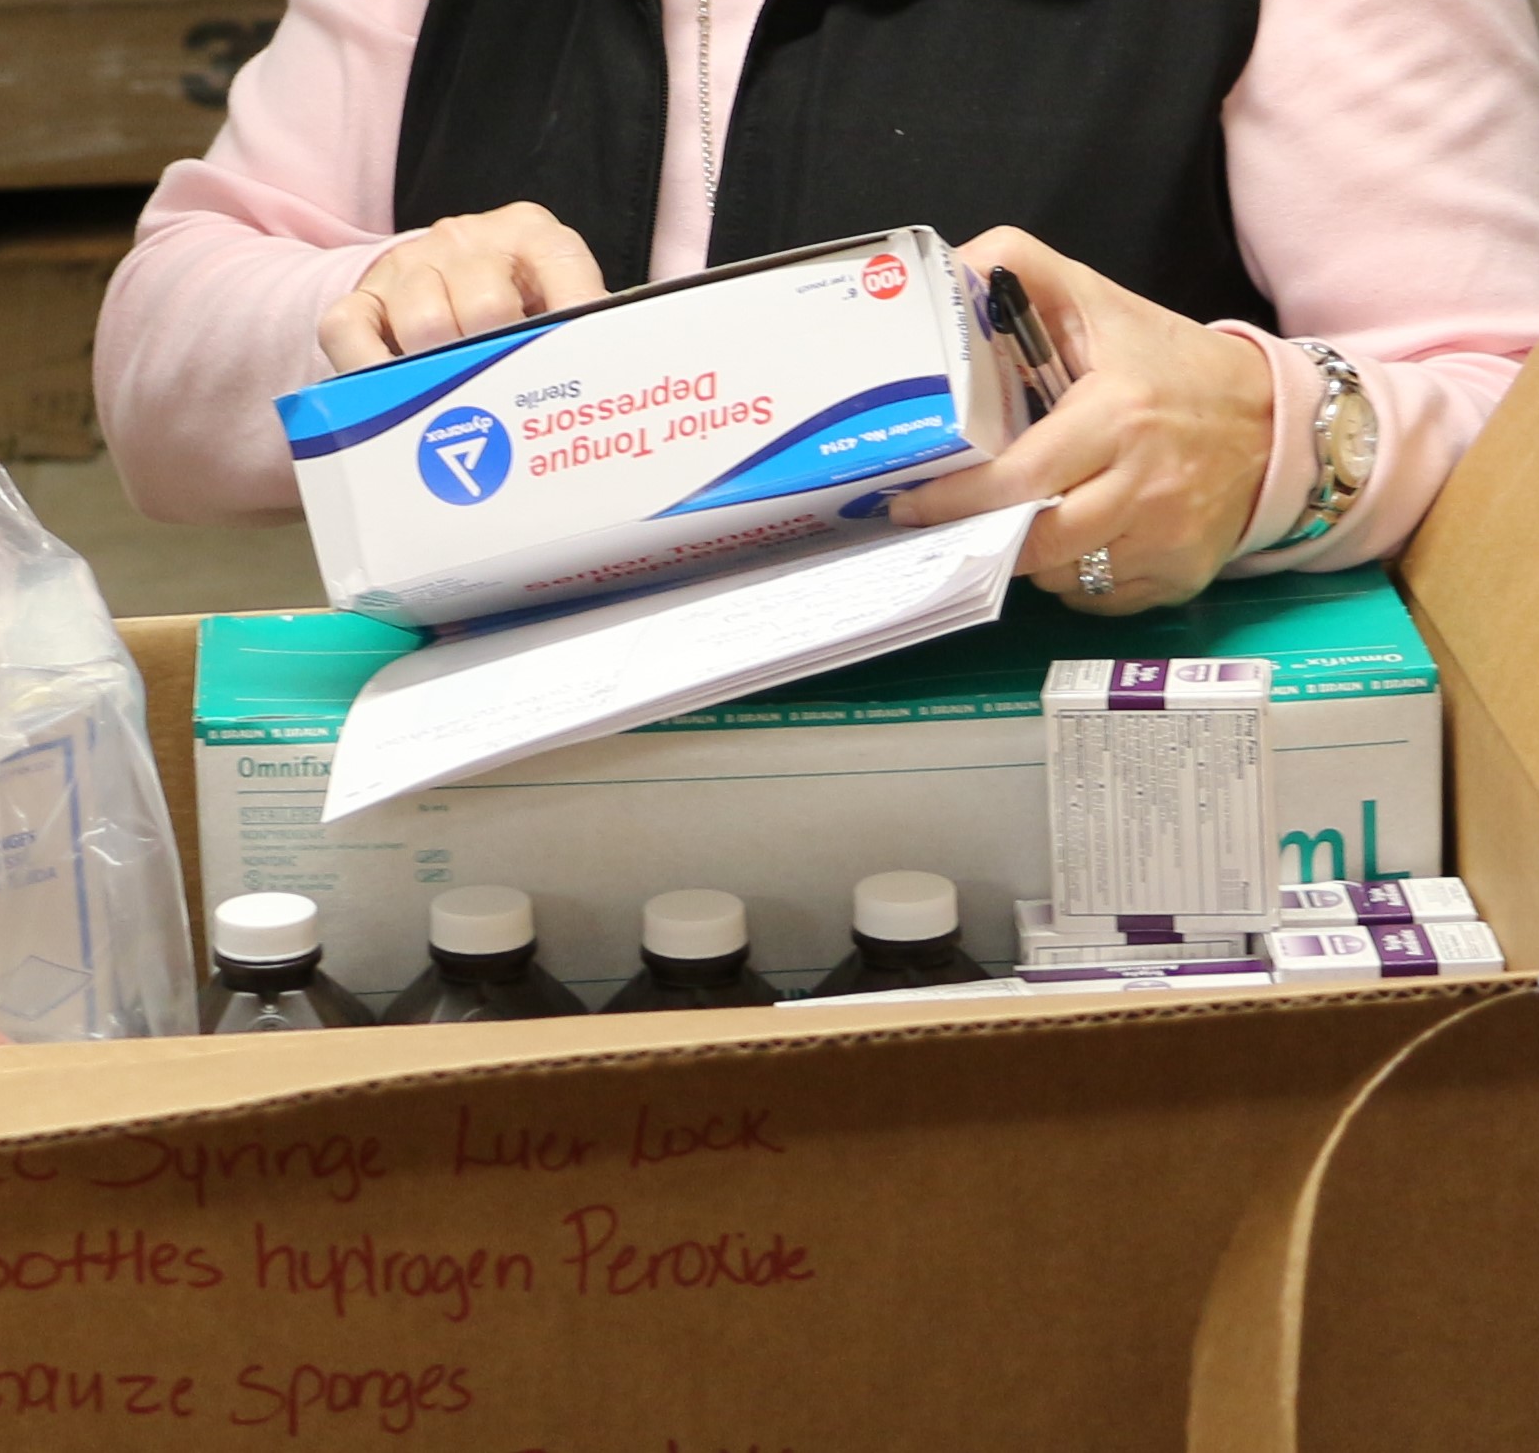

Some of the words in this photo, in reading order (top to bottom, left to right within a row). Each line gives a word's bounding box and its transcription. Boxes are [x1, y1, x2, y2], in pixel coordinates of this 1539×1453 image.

[865, 267, 908, 293] 100
[956, 309, 972, 362] Reorder
[515, 377, 584, 412] Sterile
[520, 370, 718, 443] Depressors
[425, 410, 495, 446] dynarex
[661, 392, 774, 450] Senior
[858, 425, 888, 444] No.
[887, 412, 944, 440] Reorder
[527, 420, 655, 480] Tongue
[1304, 652, 1404, 668] Omnifix
[1245, 713, 1257, 738] Drug
[238, 755, 332, 779] Omnifix
[1245, 739, 1257, 766] Facts
[453, 1104, 603, 1176] Luer
[628, 1104, 787, 1170] Lock
[254, 1221, 534, 1325] hydrogen
[563, 1203, 818, 1297] Peroxide
